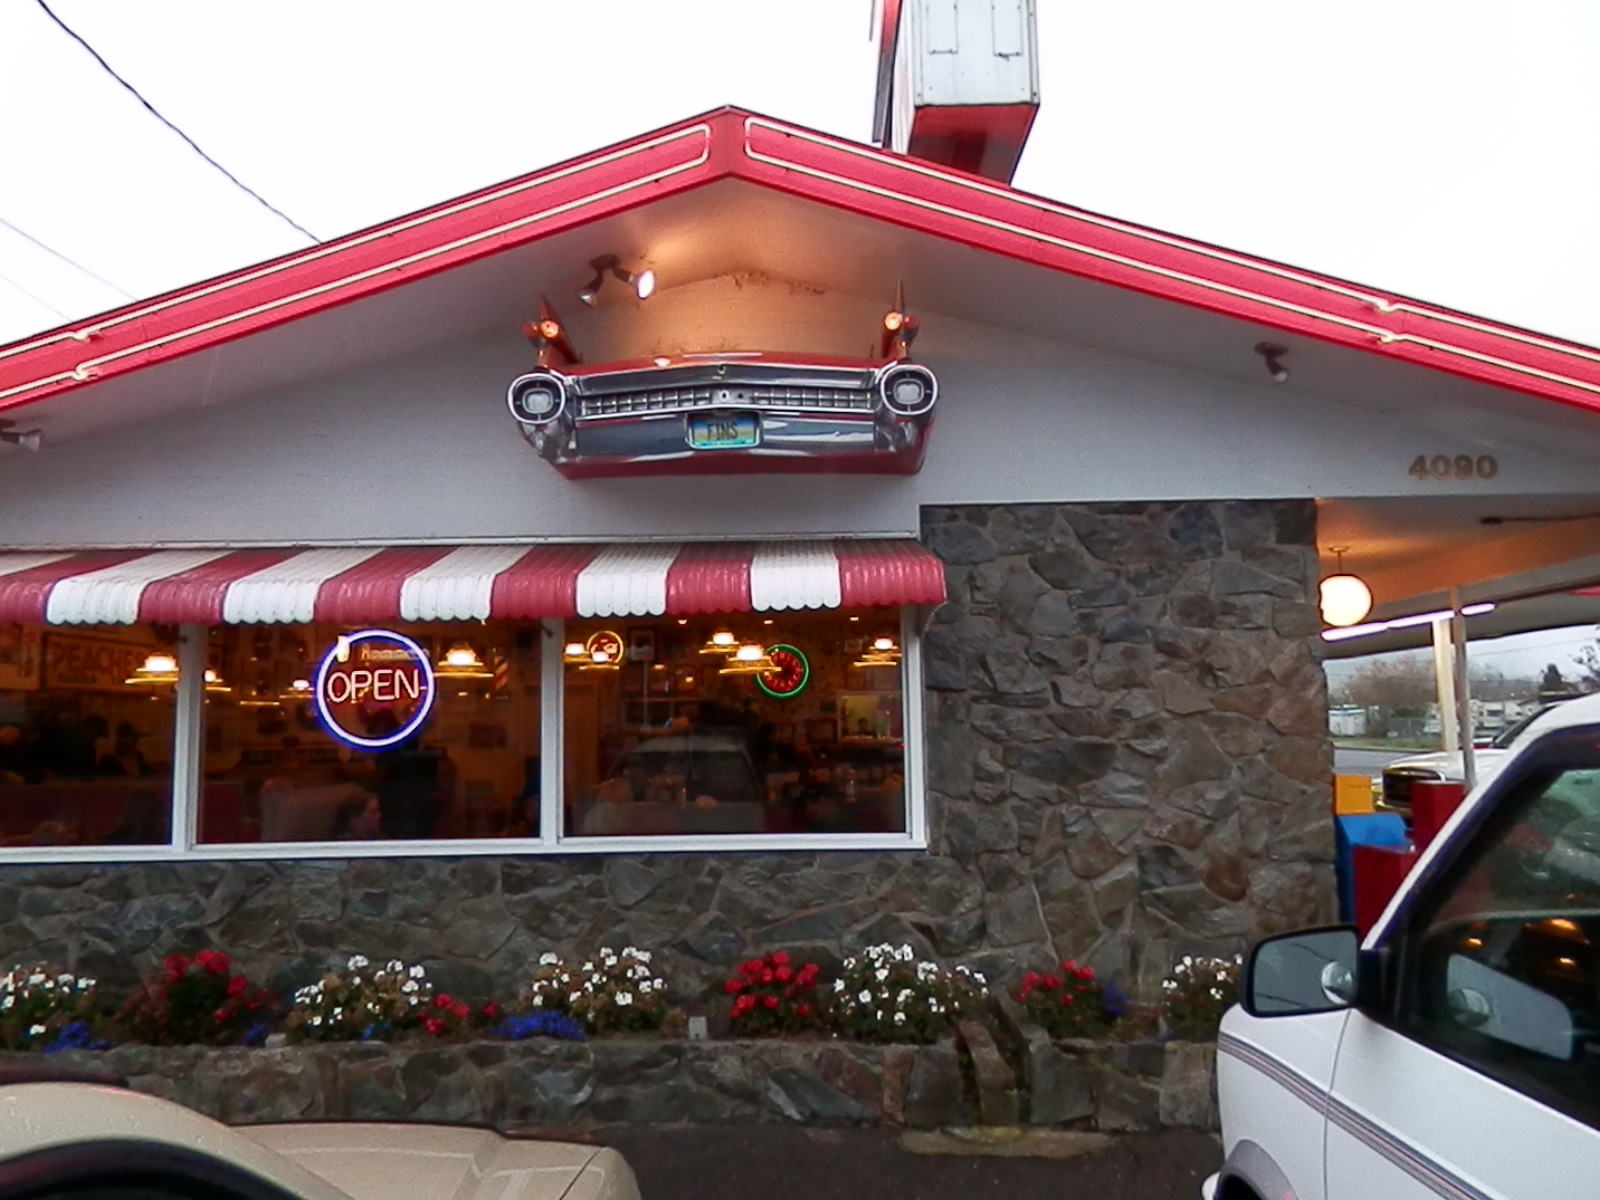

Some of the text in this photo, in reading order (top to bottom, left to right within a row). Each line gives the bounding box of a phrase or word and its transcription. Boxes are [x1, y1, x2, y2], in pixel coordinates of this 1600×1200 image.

[707, 422, 738, 441] FINS
[1408, 454, 1498, 480] 4090
[327, 668, 419, 703] OPEN
